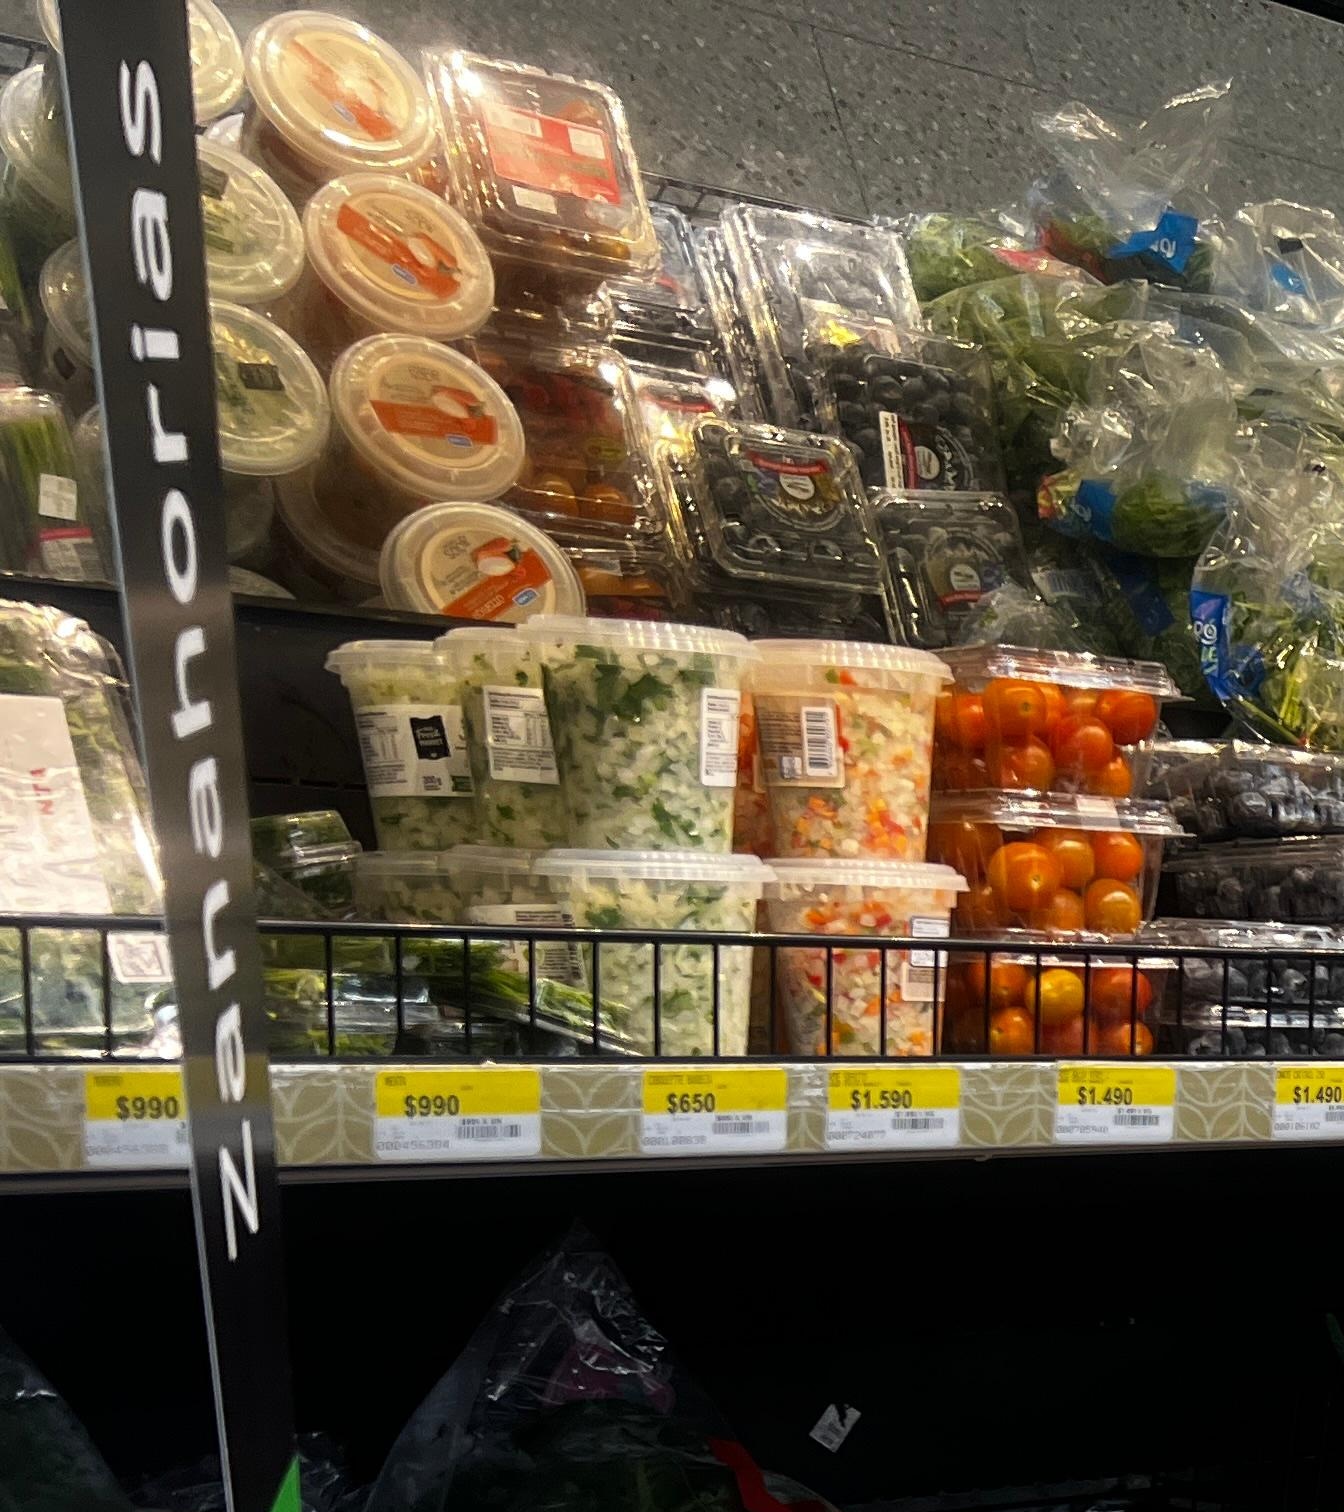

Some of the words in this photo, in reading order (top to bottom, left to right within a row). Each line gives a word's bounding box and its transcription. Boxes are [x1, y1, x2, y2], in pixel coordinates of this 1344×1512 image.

[119, 58, 260, 1262] Zanahorias
[666, 1092, 716, 1114] $650
[850, 1090, 913, 1111] $1.590
[1077, 1086, 1133, 1106] $1.490
[1293, 1086, 1342, 1104] $1.490
[116, 1095, 179, 1121] $990
[404, 1095, 460, 1120] $990
